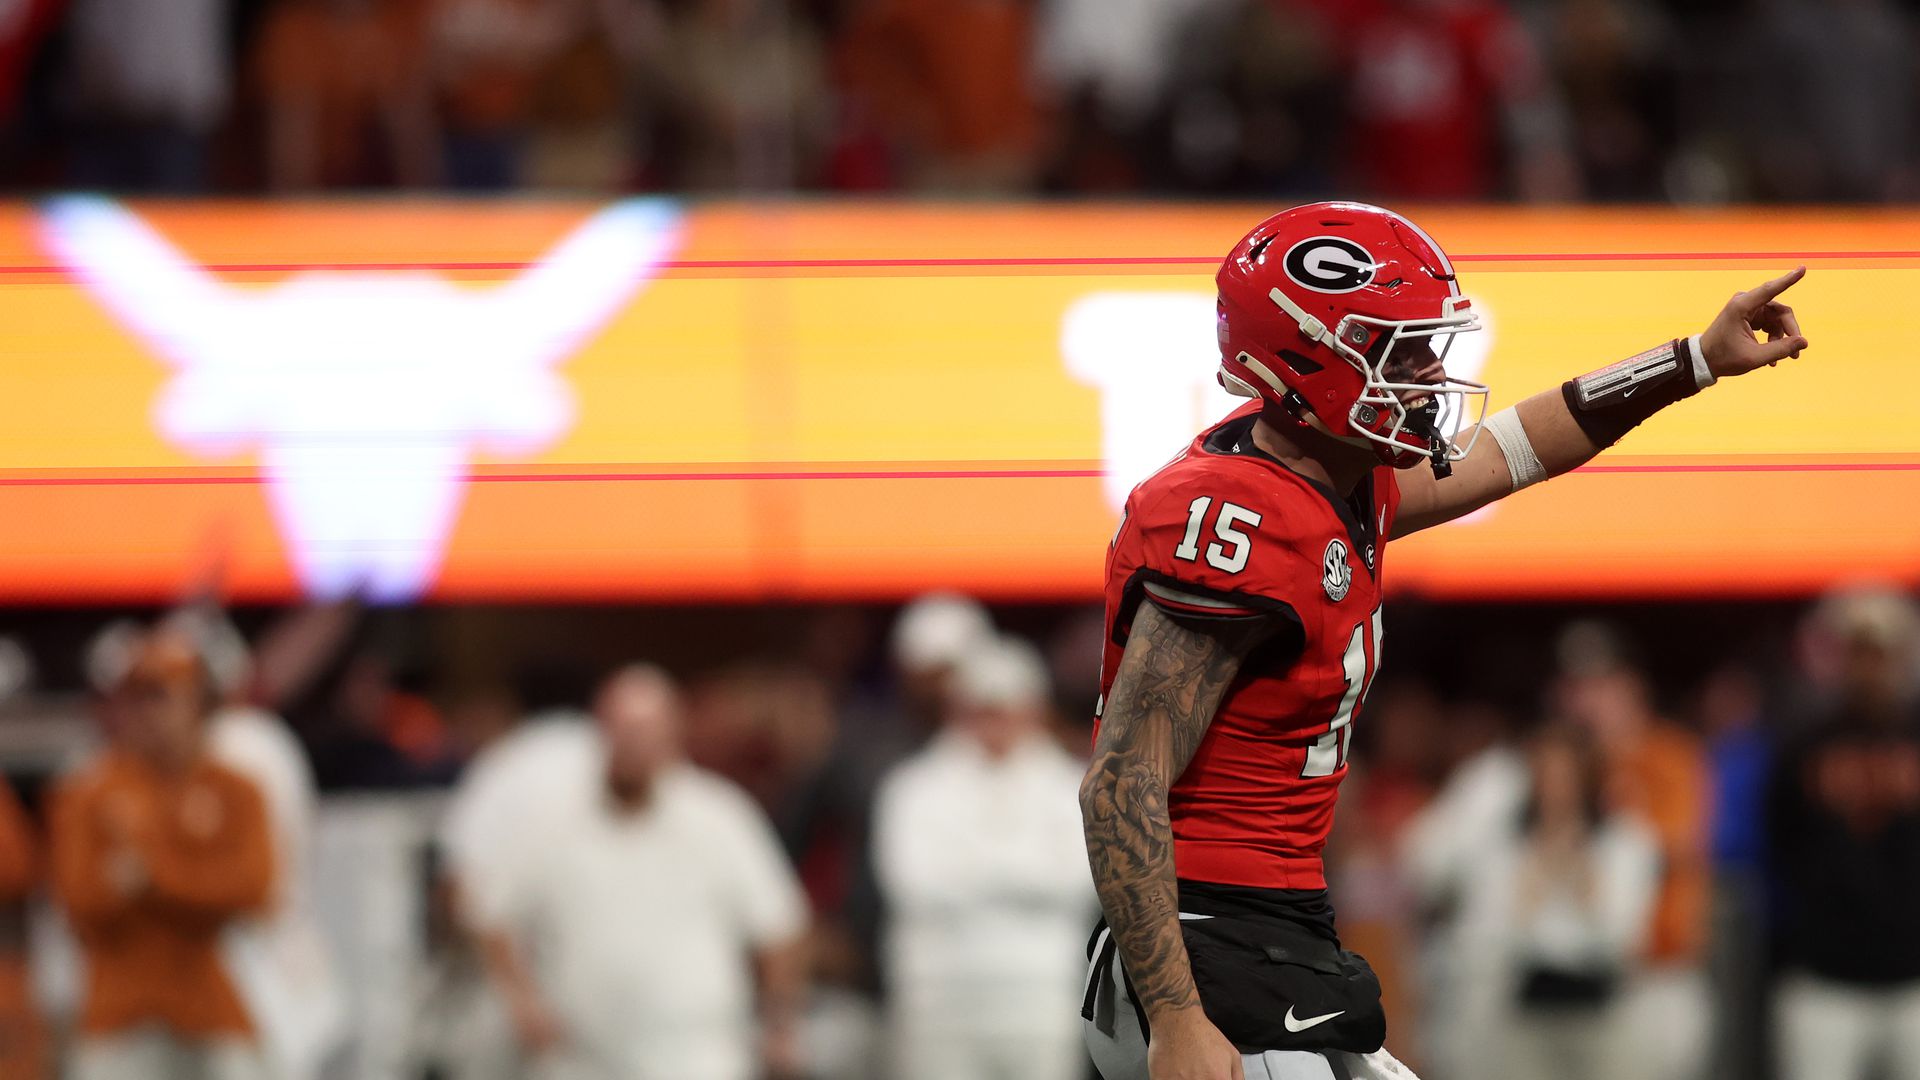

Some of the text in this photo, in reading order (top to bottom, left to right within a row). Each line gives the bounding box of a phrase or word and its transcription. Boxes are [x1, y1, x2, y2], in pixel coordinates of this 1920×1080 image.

[1286, 238, 1375, 291] G
[1173, 495, 1263, 575] 15
[1325, 541, 1347, 587] SEC
